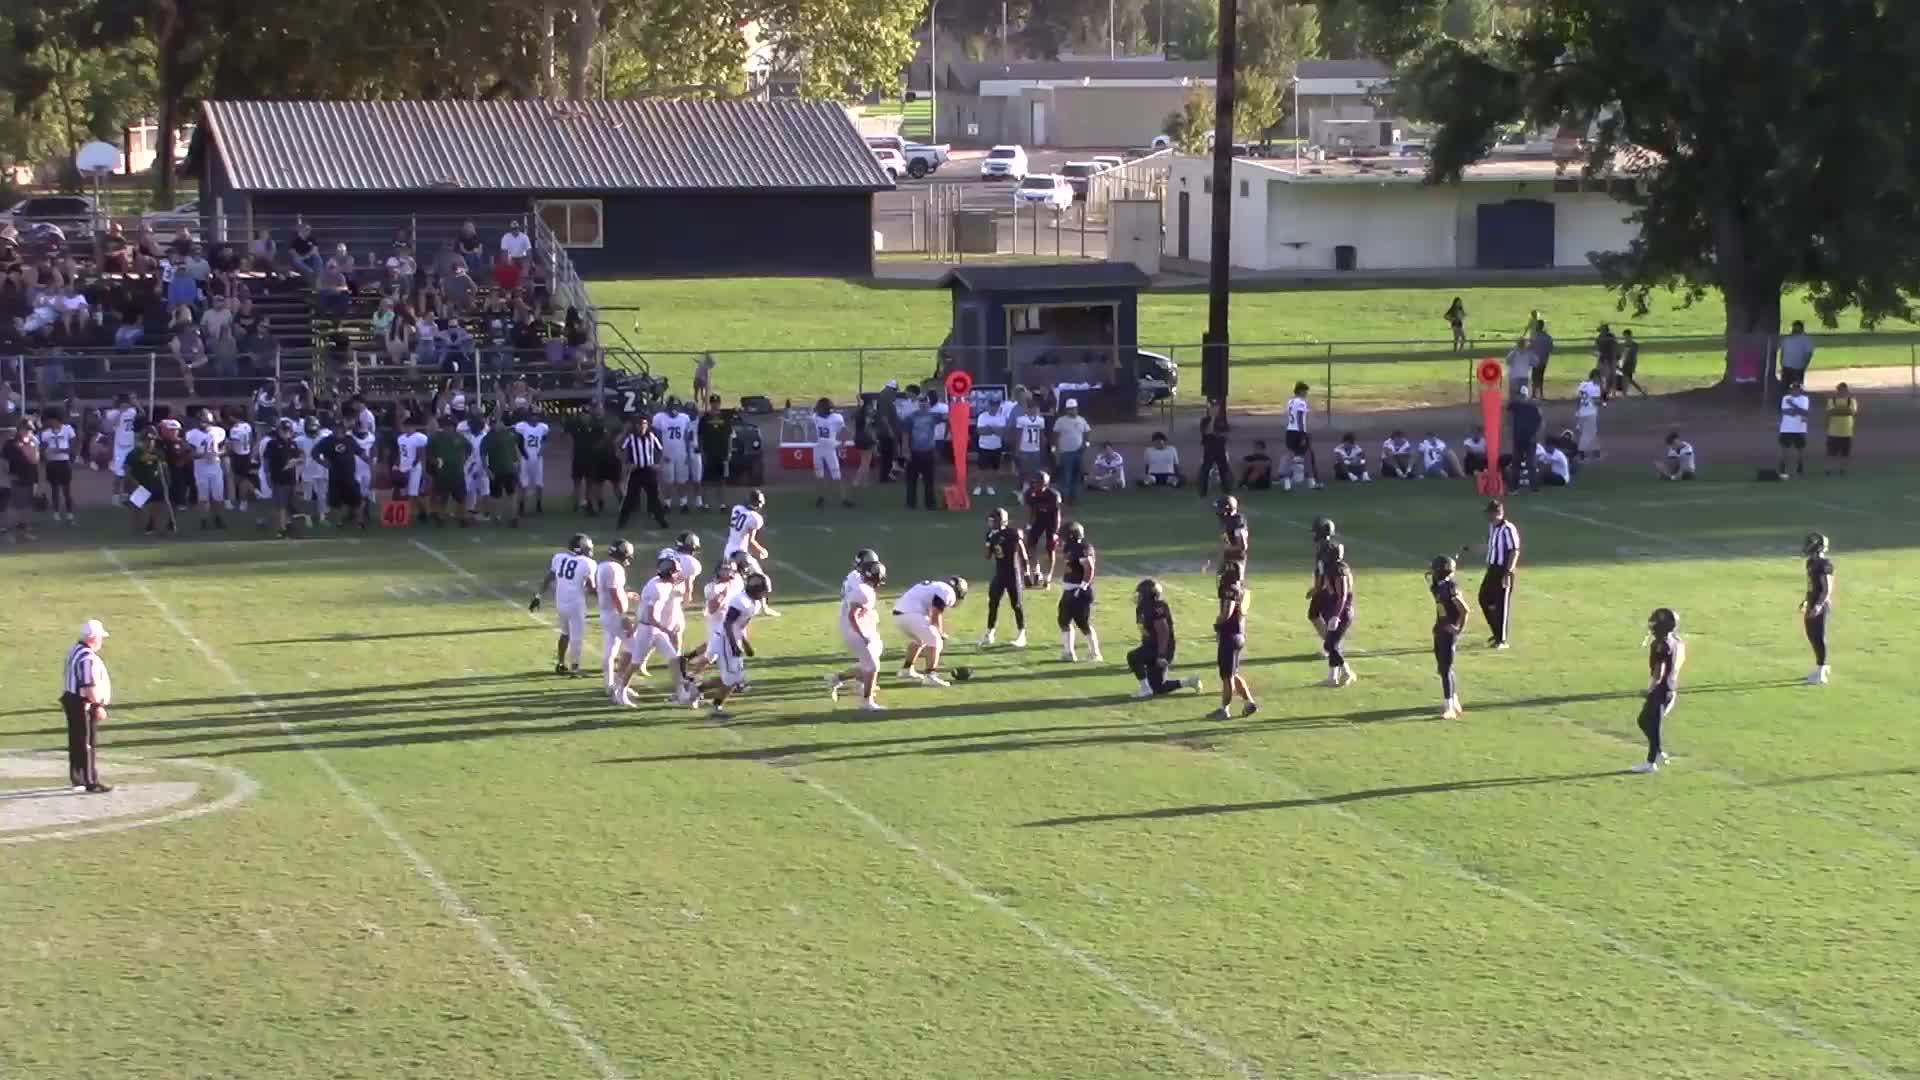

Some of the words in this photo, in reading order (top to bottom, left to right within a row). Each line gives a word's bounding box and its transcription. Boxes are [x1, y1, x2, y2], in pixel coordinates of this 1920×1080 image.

[623, 391, 636, 412] 2
[384, 504, 405, 523] 40
[730, 510, 747, 531] 20
[558, 558, 578, 580] 18
